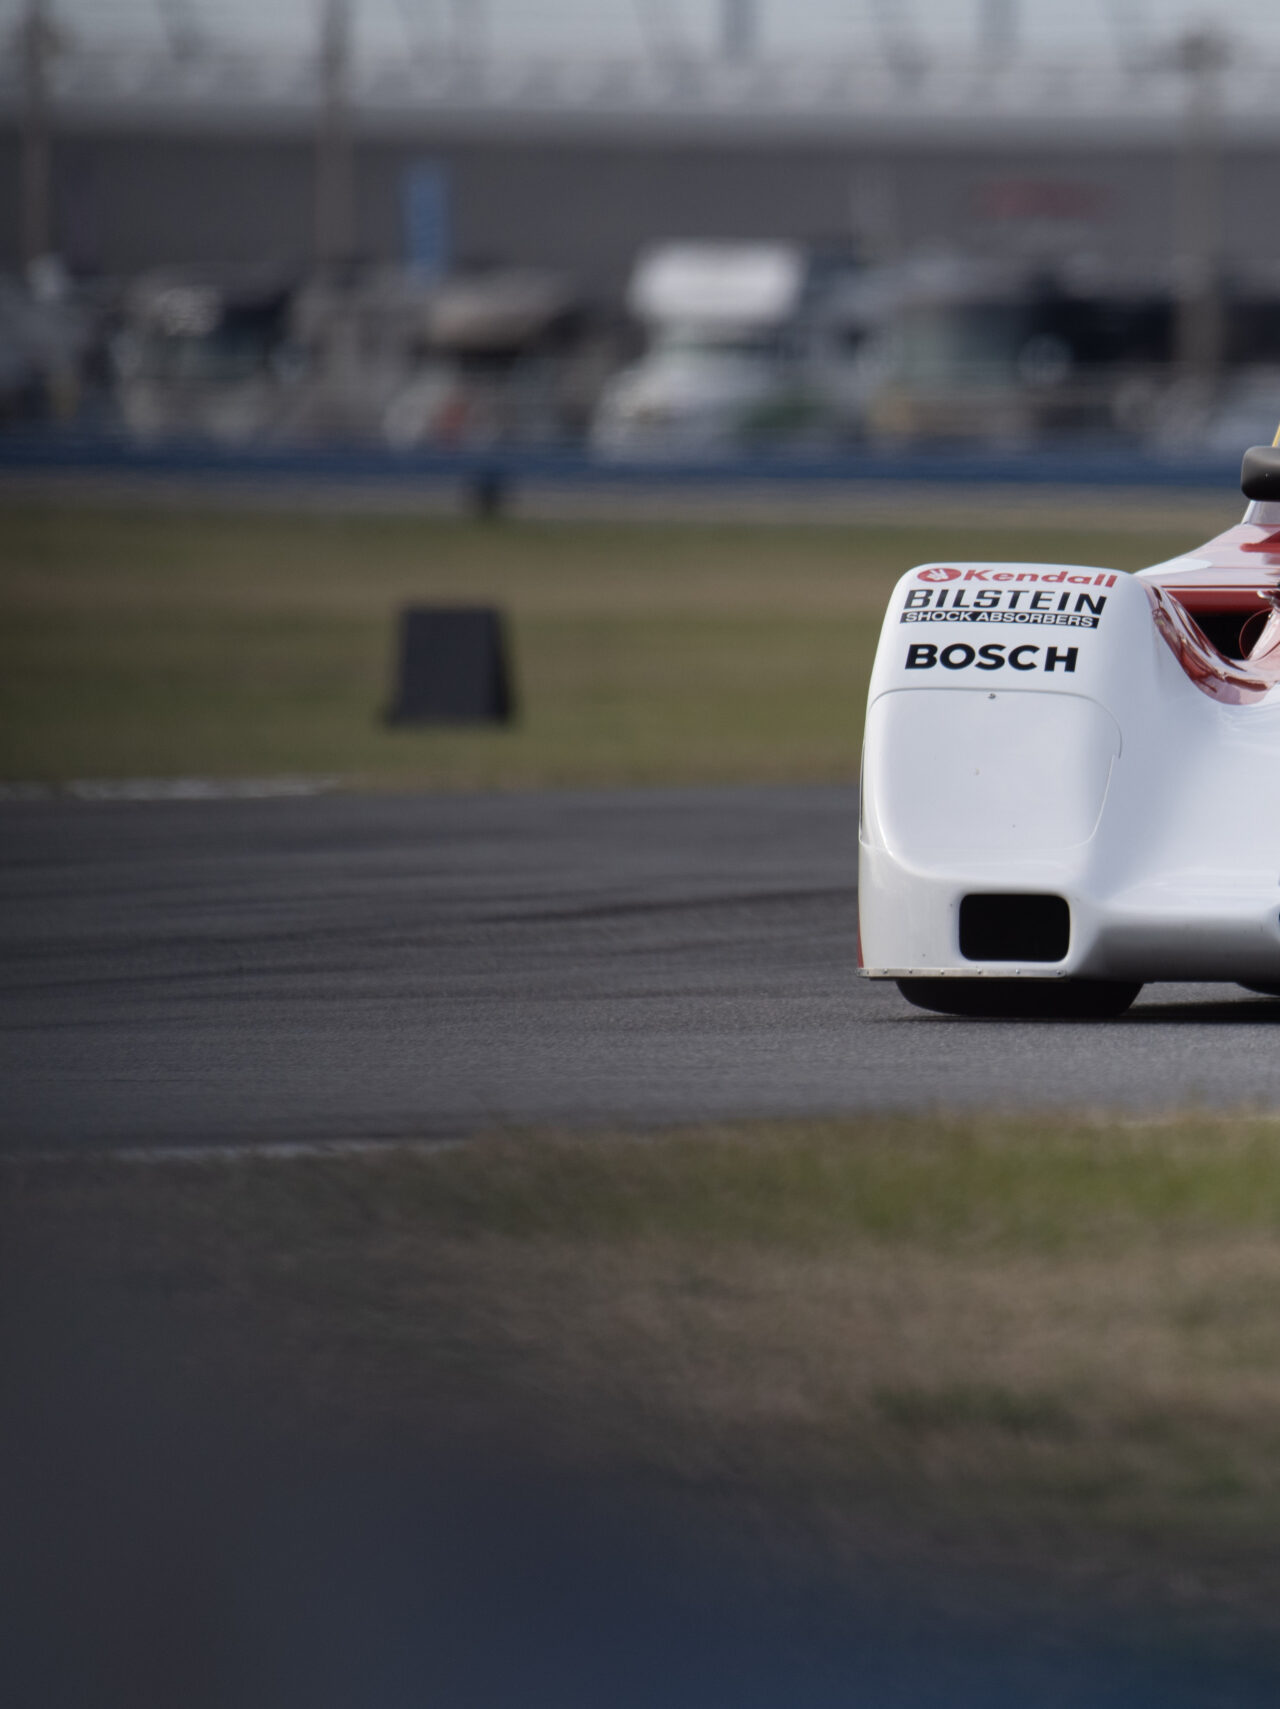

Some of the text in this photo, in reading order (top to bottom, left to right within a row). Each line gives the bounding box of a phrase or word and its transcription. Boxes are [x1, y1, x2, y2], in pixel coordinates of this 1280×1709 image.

[961, 569, 1118, 588] Kendall
[903, 588, 1108, 616] BILSTEIN
[905, 611, 1094, 628] SHOCK ABSORBERS
[904, 643, 1079, 673] BOSCH
